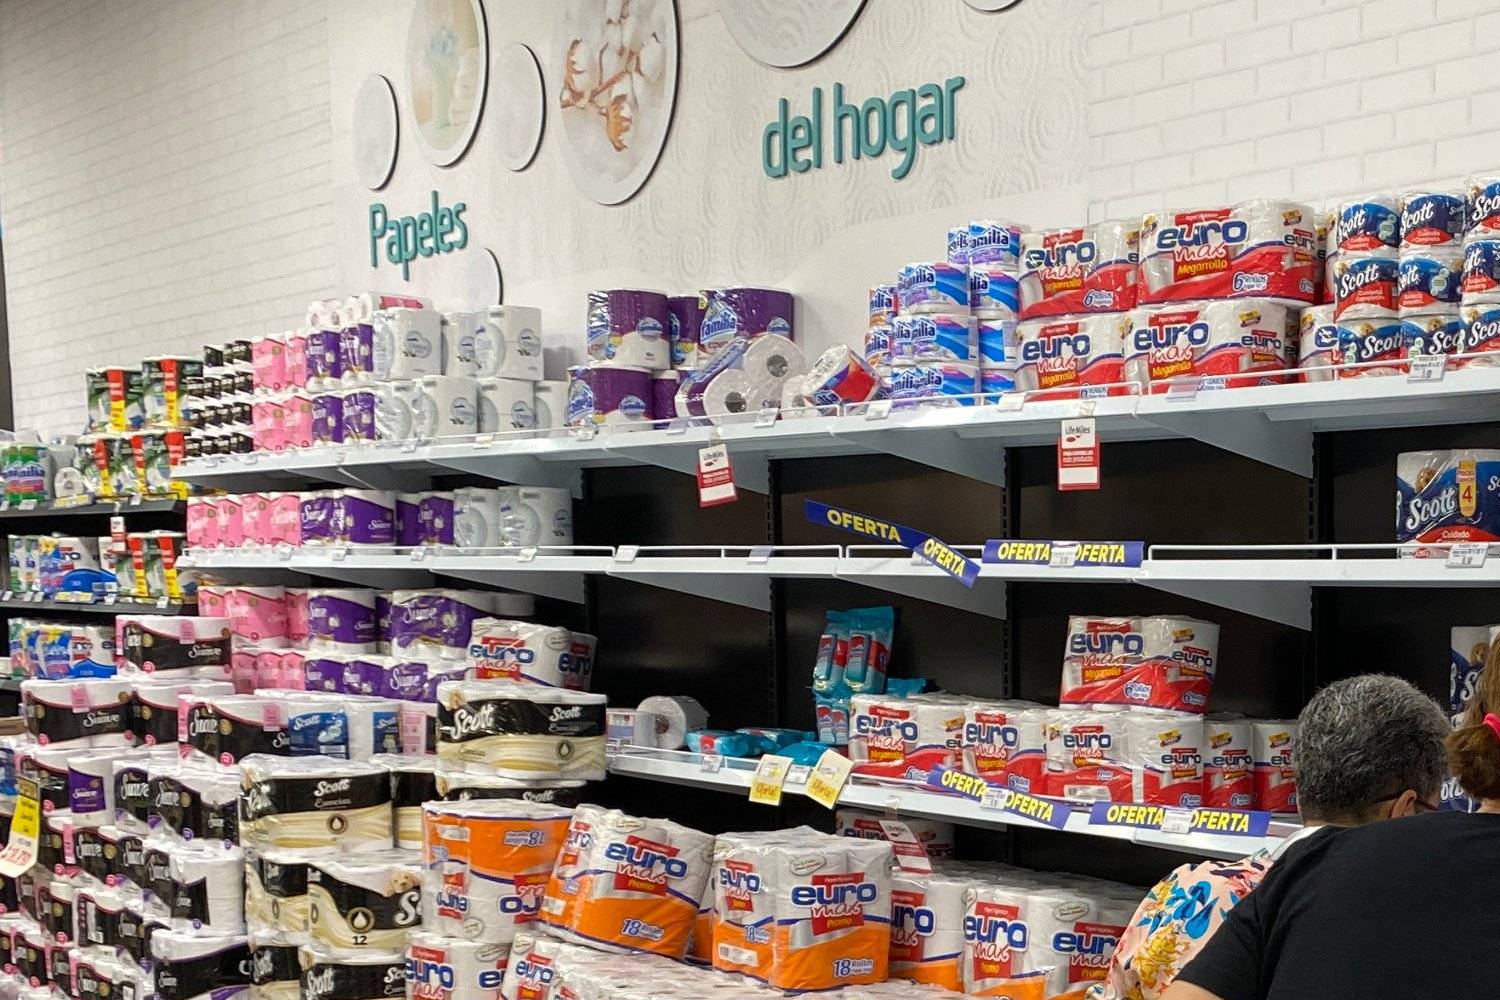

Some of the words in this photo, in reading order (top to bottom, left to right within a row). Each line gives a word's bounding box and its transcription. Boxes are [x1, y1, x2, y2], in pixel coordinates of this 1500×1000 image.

[762, 84, 822, 179] del
[834, 76, 965, 181] hogar
[369, 191, 469, 281] Papeles
[1157, 219, 1248, 248] euro
[1025, 240, 1096, 268] euro
[1339, 263, 1380, 297] Scott
[1022, 332, 1090, 361] euro
[1462, 485, 1473, 503] 4
[1407, 487, 1455, 532] Scott
[826, 508, 901, 542] OFERTA
[924, 538, 966, 578] OFERTA
[997, 542, 1050, 561] OFERTA
[188, 644, 222, 660] Suave
[470, 644, 535, 664] euro
[1069, 631, 1144, 654] euro
[558, 652, 592, 675] euro
[1171, 650, 1213, 667] euro
[82, 711, 120, 730] Suave
[294, 712, 321, 731] Scott
[450, 703, 496, 740] Scott
[550, 706, 581, 722] Scott
[856, 714, 919, 743] euro
[965, 722, 1019, 747] euro
[1063, 732, 1112, 749] euro
[1161, 754, 1201, 765] euro
[313, 778, 351, 797] Scott
[941, 770, 988, 799] OFERTA
[1106, 805, 1163, 824] OFERTA
[605, 842, 688, 879] euro
[616, 863, 666, 884] max
[719, 867, 761, 895] euro
[790, 882, 878, 907] euro
[811, 902, 861, 918] max
[352, 935, 369, 946] 12
[962, 913, 1029, 952] euro
[405, 958, 454, 989] euro
[515, 961, 553, 984] euro
[831, 957, 851, 978] 18
